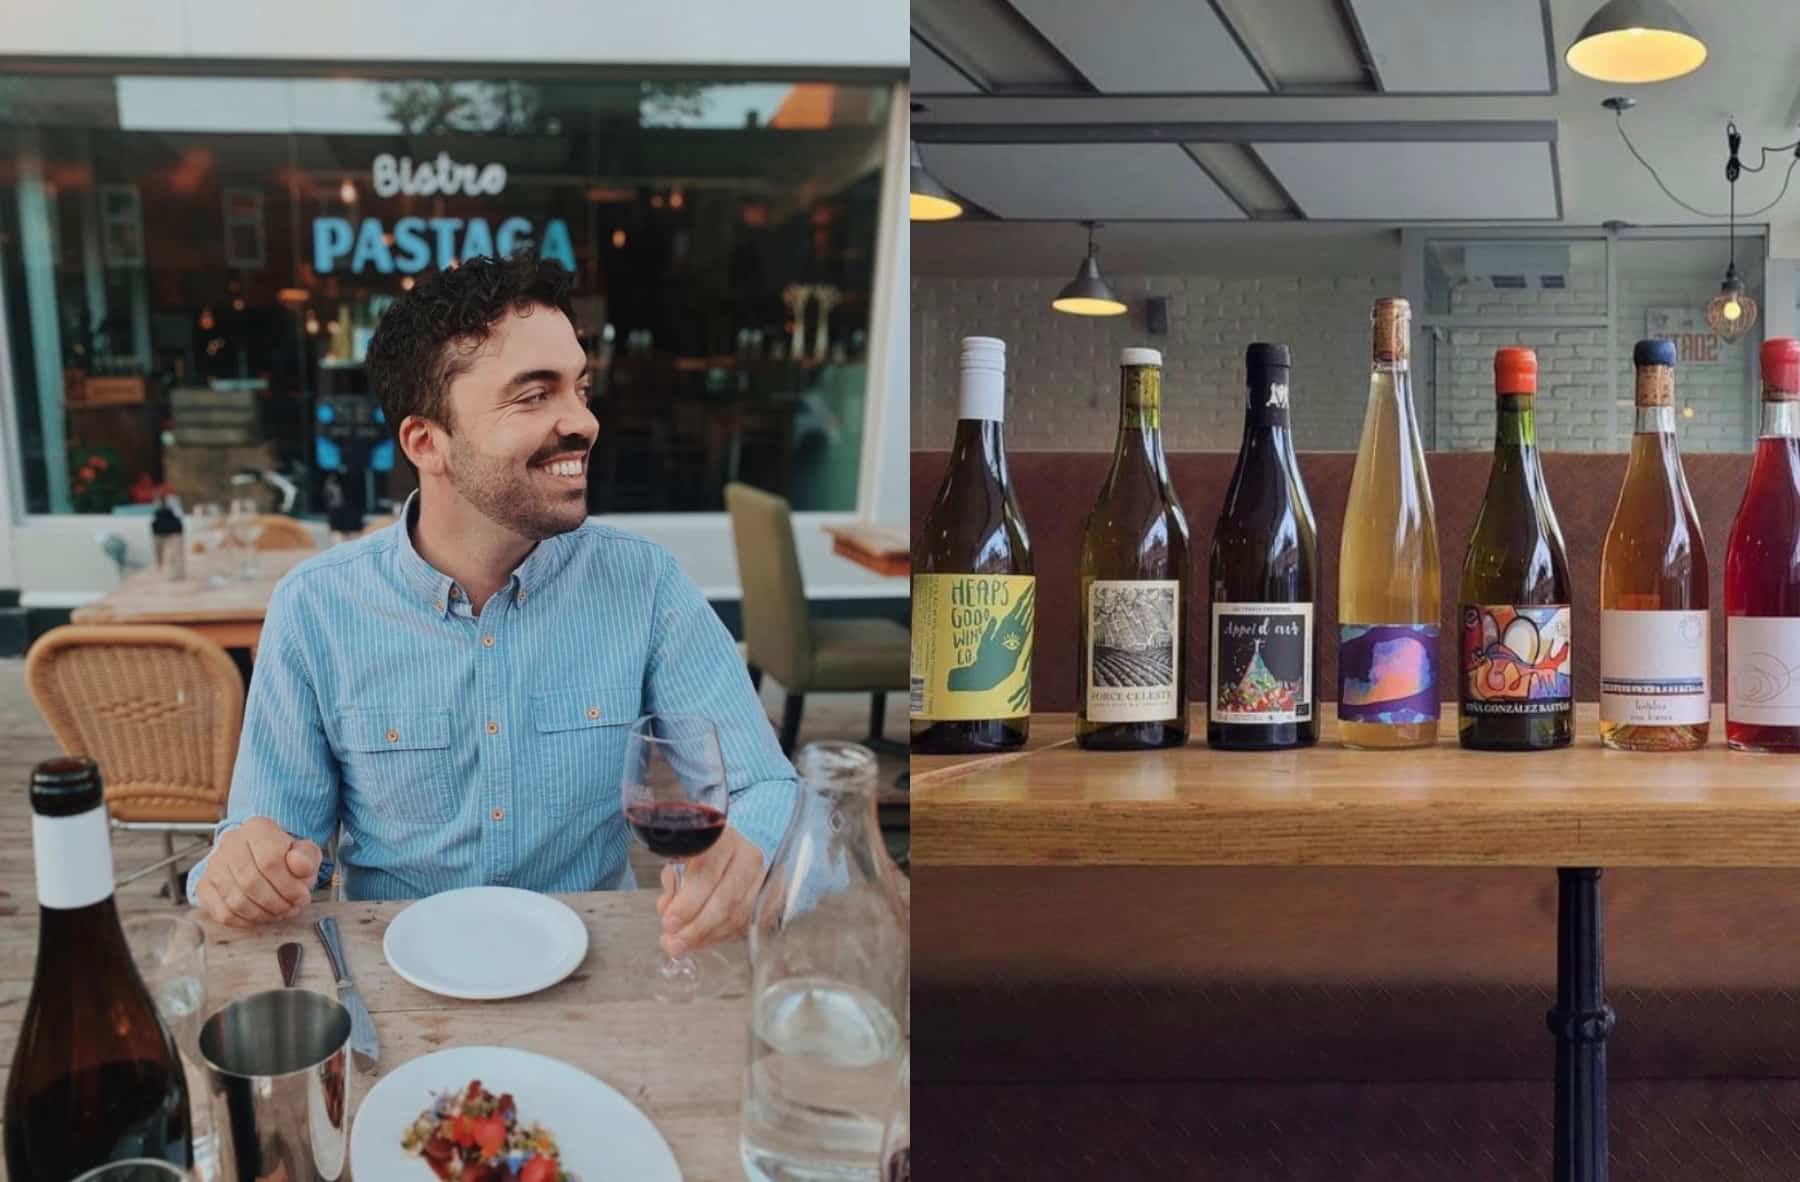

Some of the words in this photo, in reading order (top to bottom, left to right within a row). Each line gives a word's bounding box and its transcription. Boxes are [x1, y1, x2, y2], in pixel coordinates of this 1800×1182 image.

[373, 151, 507, 197] Bistro
[951, 577, 1009, 607] HEAPS
[951, 607, 990, 628] GOOD
